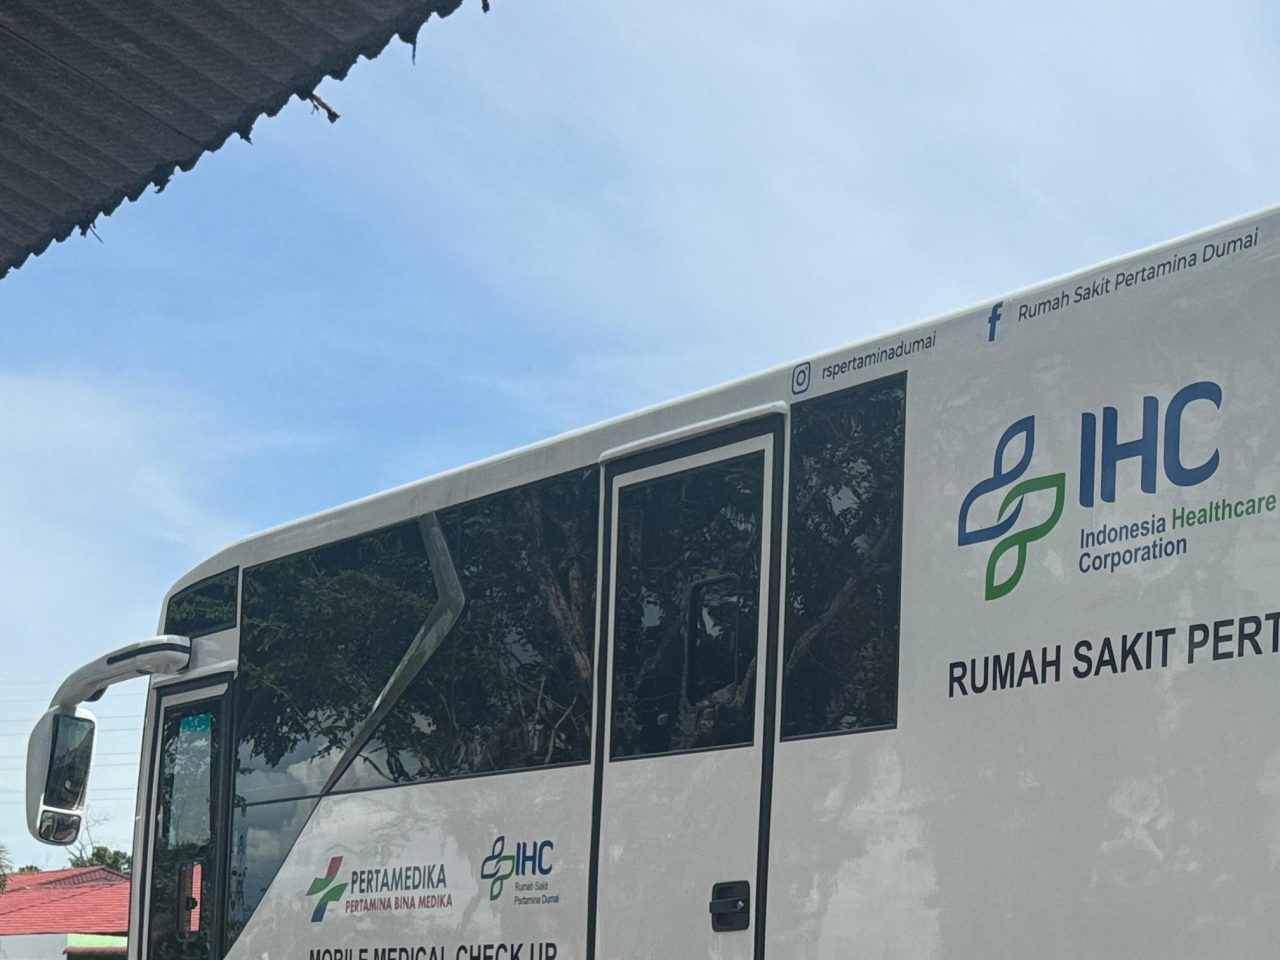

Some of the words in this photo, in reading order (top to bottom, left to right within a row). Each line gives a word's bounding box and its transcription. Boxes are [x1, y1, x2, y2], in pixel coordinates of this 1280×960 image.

[1018, 291, 1070, 322] Rumah
[1073, 278, 1111, 305] Sakit
[1114, 252, 1197, 292] Pertamina
[1202, 227, 1260, 263] Dumai
[821, 331, 937, 381] rspertaminadumai
[1079, 381, 1222, 508] IHC
[1080, 514, 1166, 549] Indonesia
[1172, 493, 1277, 529] Healthcare
[1079, 537, 1187, 573] Corporation
[948, 645, 1061, 698] RUMAH
[1072, 627, 1177, 678] SAKIT
[350, 863, 447, 894] PERTAMEDIKA
[515, 840, 554, 876] IHC
[345, 897, 392, 913] PERTAMINA
[394, 895, 416, 911] BINA
[418, 894, 453, 909] MEDIKA
